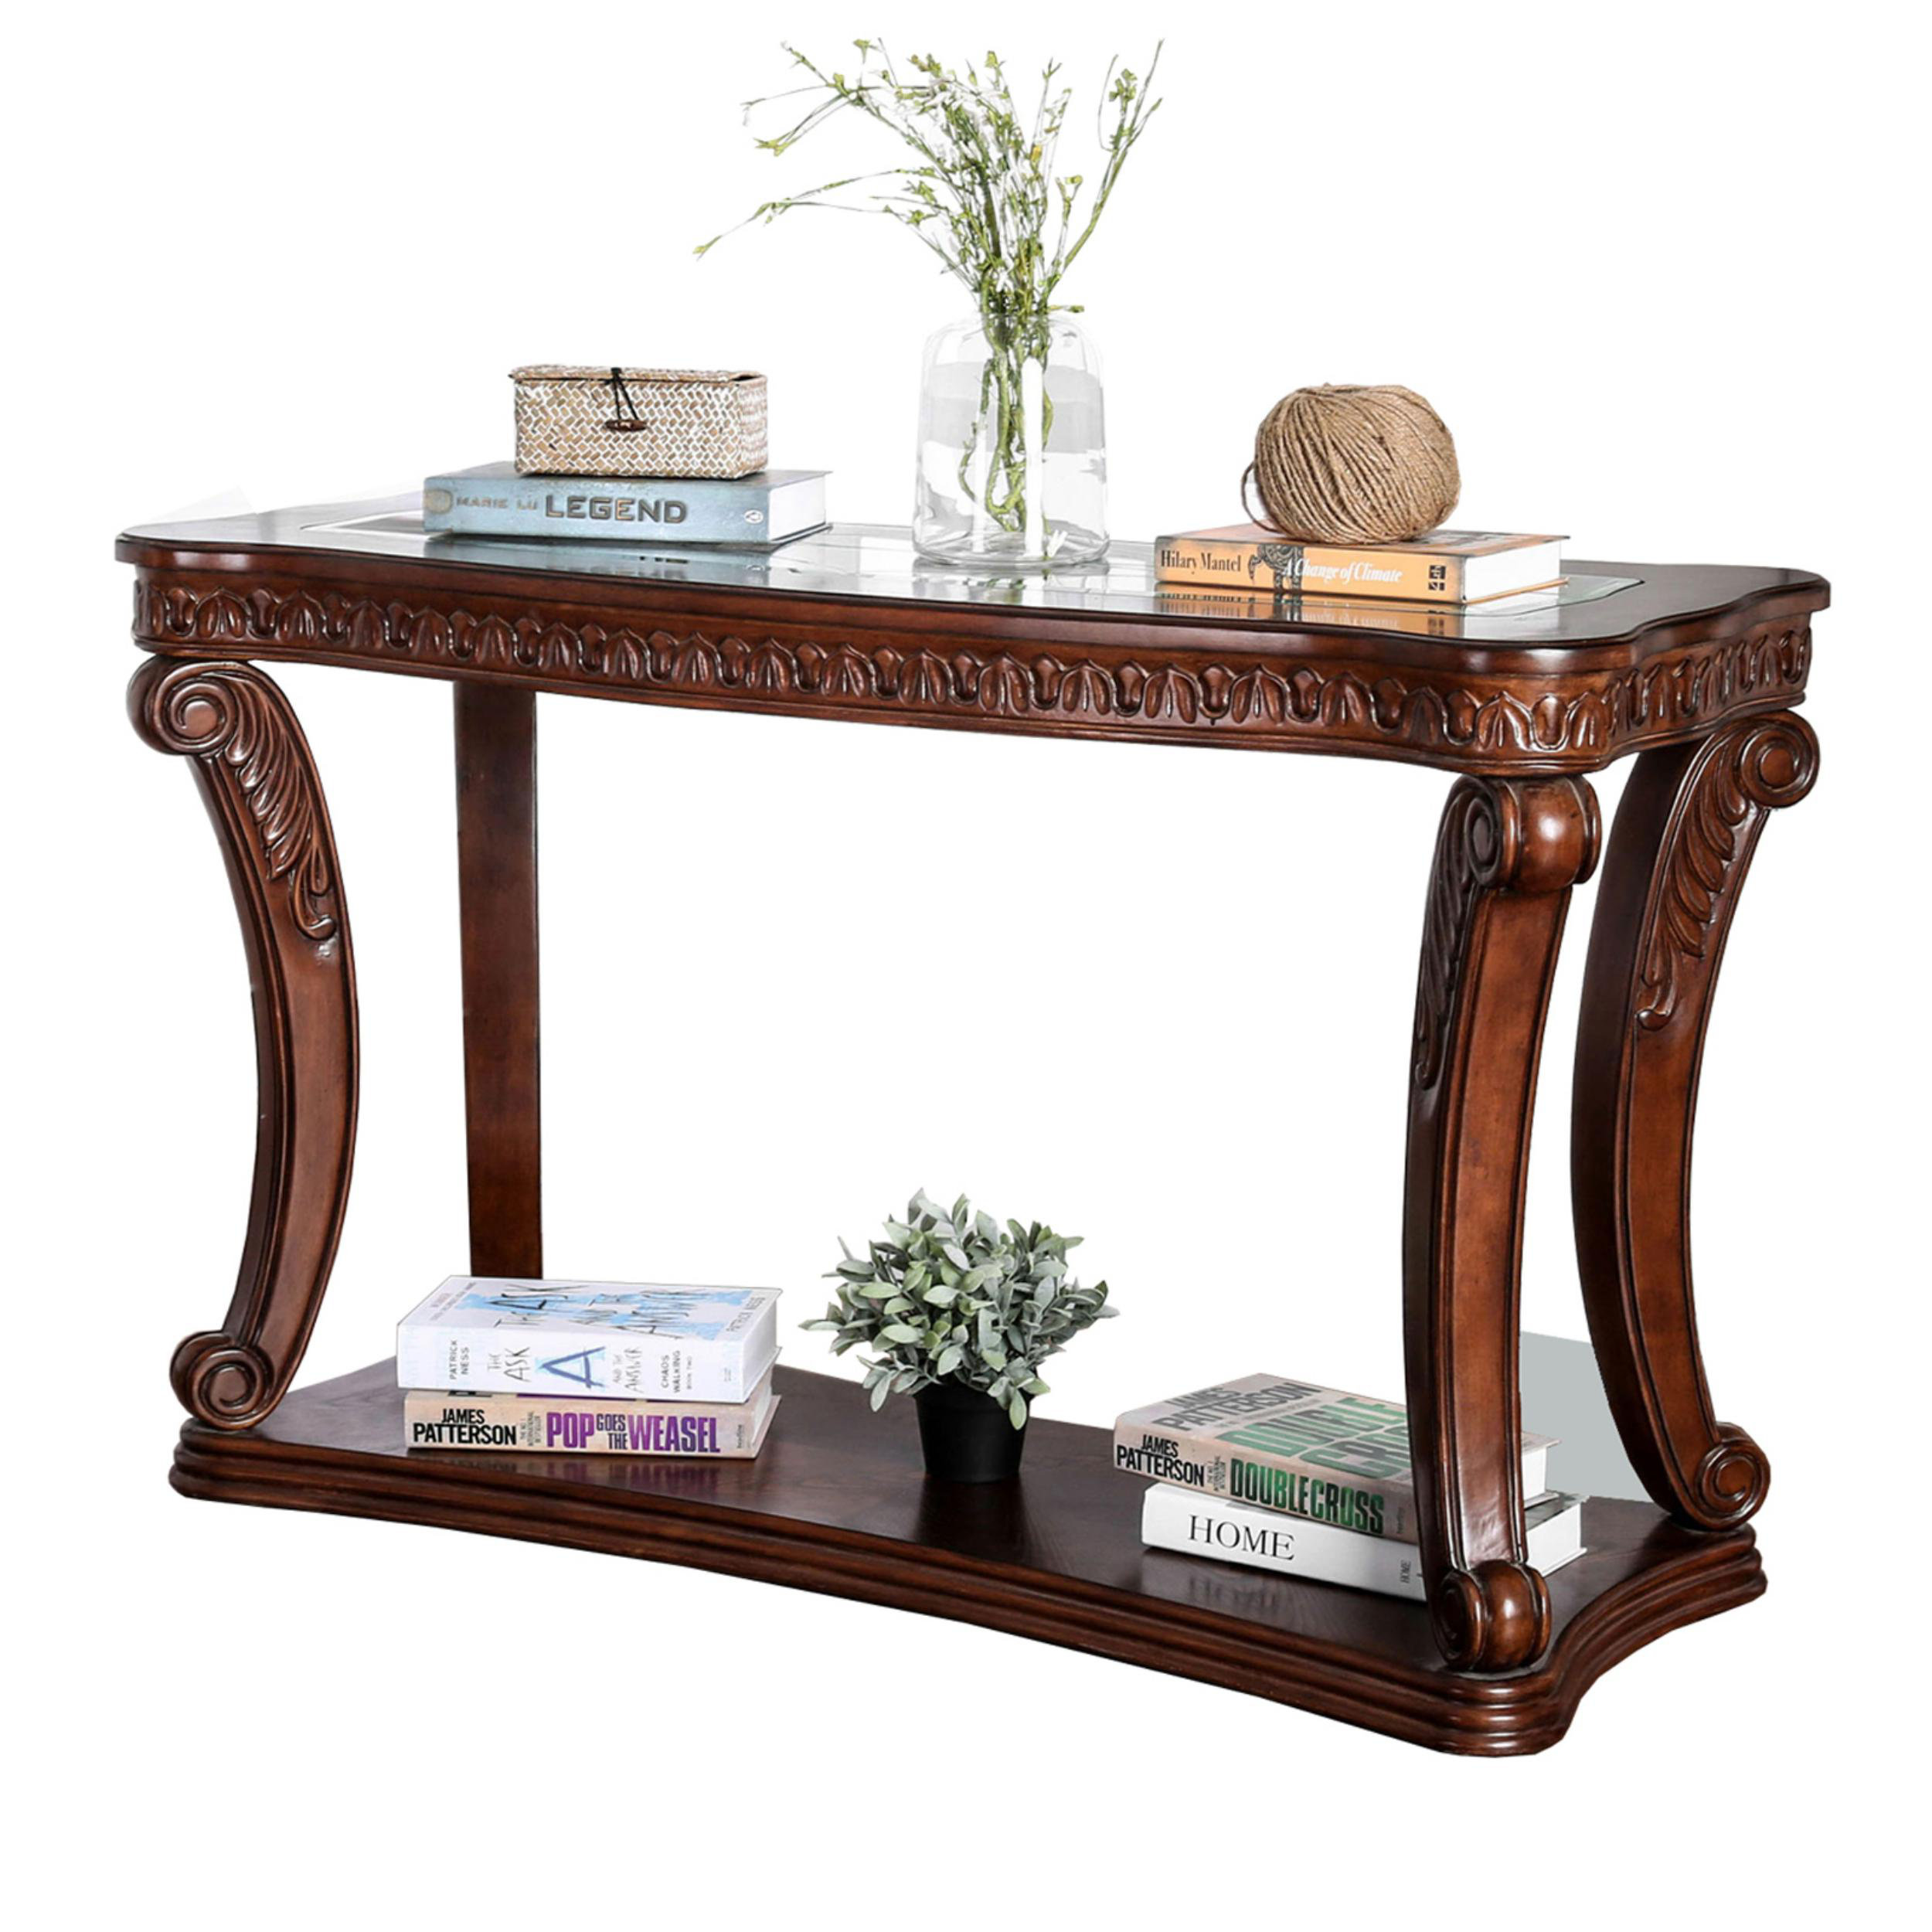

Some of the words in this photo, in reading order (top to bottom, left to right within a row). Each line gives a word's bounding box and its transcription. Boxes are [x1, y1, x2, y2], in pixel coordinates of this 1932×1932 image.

[545, 493, 688, 525] LEGEND
[1161, 549, 1197, 575] Hilary
[1200, 552, 1241, 572] Mantel
[1294, 558, 1339, 583] Change
[1340, 561, 1356, 585] of
[1352, 562, 1403, 583] Climate
[449, 1339, 457, 1380] PATRICK
[460, 1346, 469, 1375] NESS
[502, 1346, 530, 1383] ASK
[538, 1346, 607, 1389] A
[660, 1354, 670, 1389] CHAOS
[672, 1350, 682, 1393] WALKING
[441, 1408, 485, 1424] JAMES
[596, 1413, 626, 1432] GOES
[1151, 1382, 1322, 1431] PATTERSON
[413, 1422, 517, 1446] PATTERSON
[546, 1411, 595, 1449] POP
[607, 1432, 628, 1451] THE
[627, 1414, 721, 1454] WEASEL
[1141, 1434, 1179, 1458] JAMES
[1116, 1444, 1205, 1488] PATTERSON
[1188, 1514, 1295, 1561] HOME
[1400, 1560, 1411, 1584] HOME
